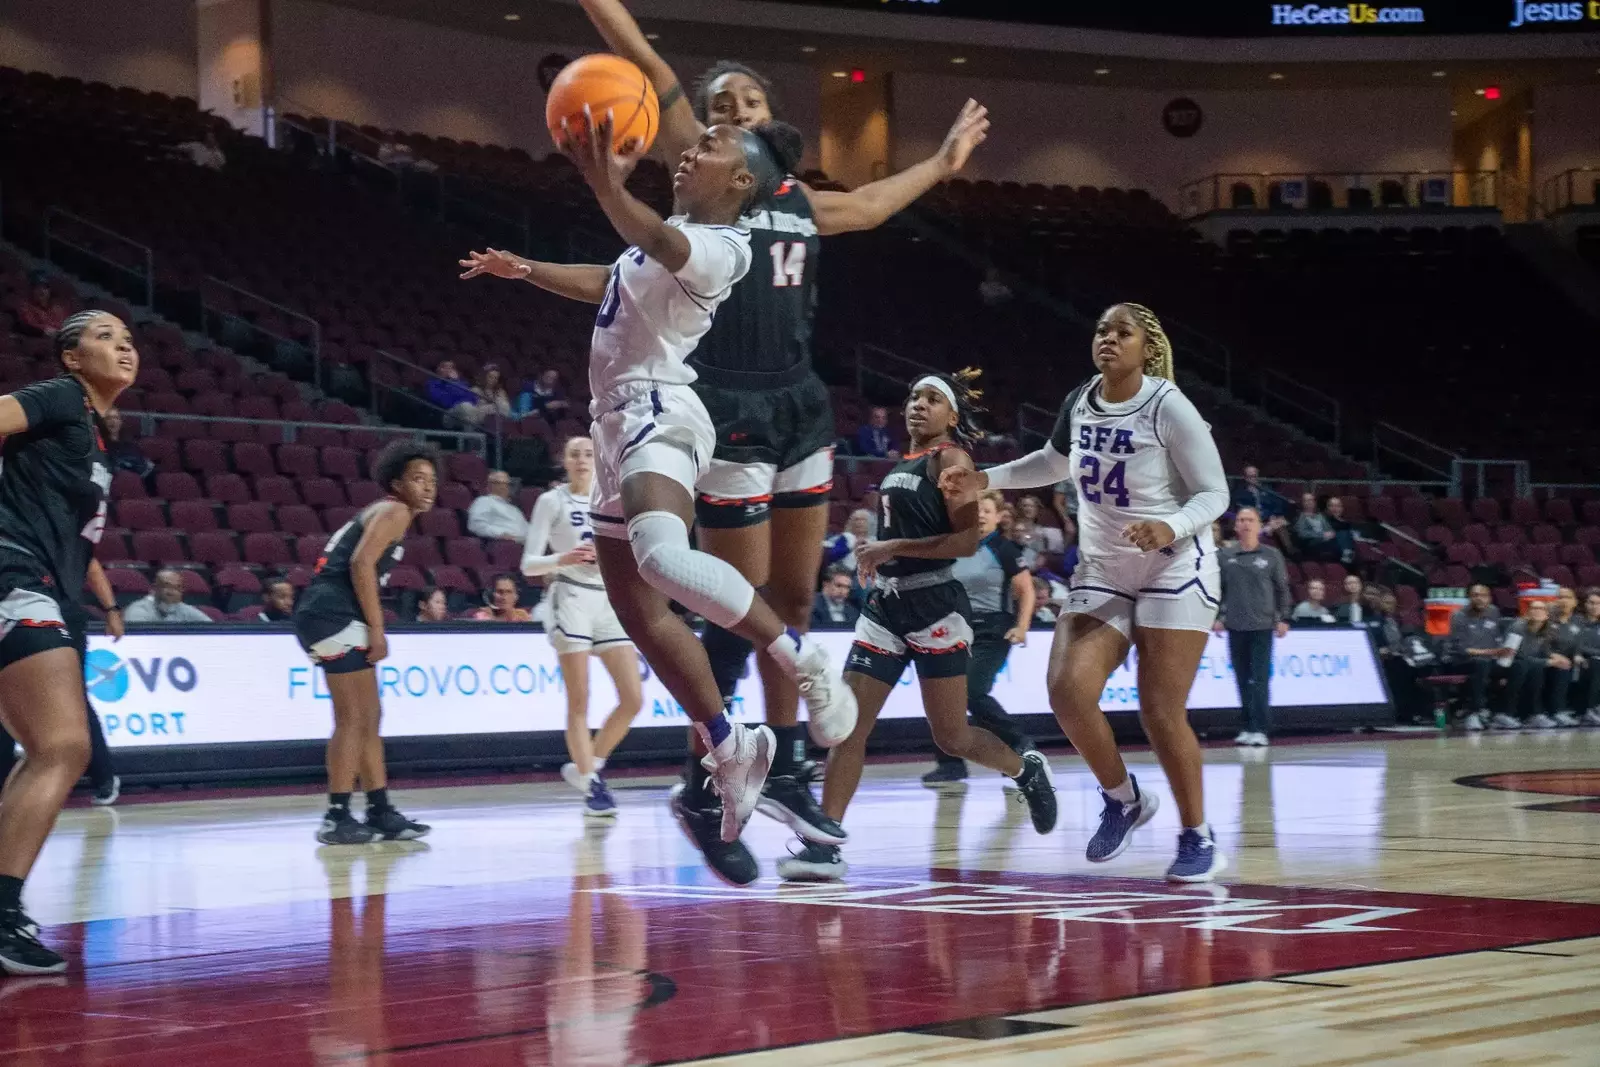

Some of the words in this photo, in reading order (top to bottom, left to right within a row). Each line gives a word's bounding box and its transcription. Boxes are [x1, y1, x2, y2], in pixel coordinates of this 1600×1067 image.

[1271, 3, 1425, 24] HeGetsUs.com
[1509, 0, 1583, 27] Jesus
[769, 240, 807, 287] 14
[1079, 425, 1136, 454] SFA
[1079, 455, 1130, 507] 24
[288, 663, 565, 700] FLROVO.COM
[104, 711, 186, 737] PORT
